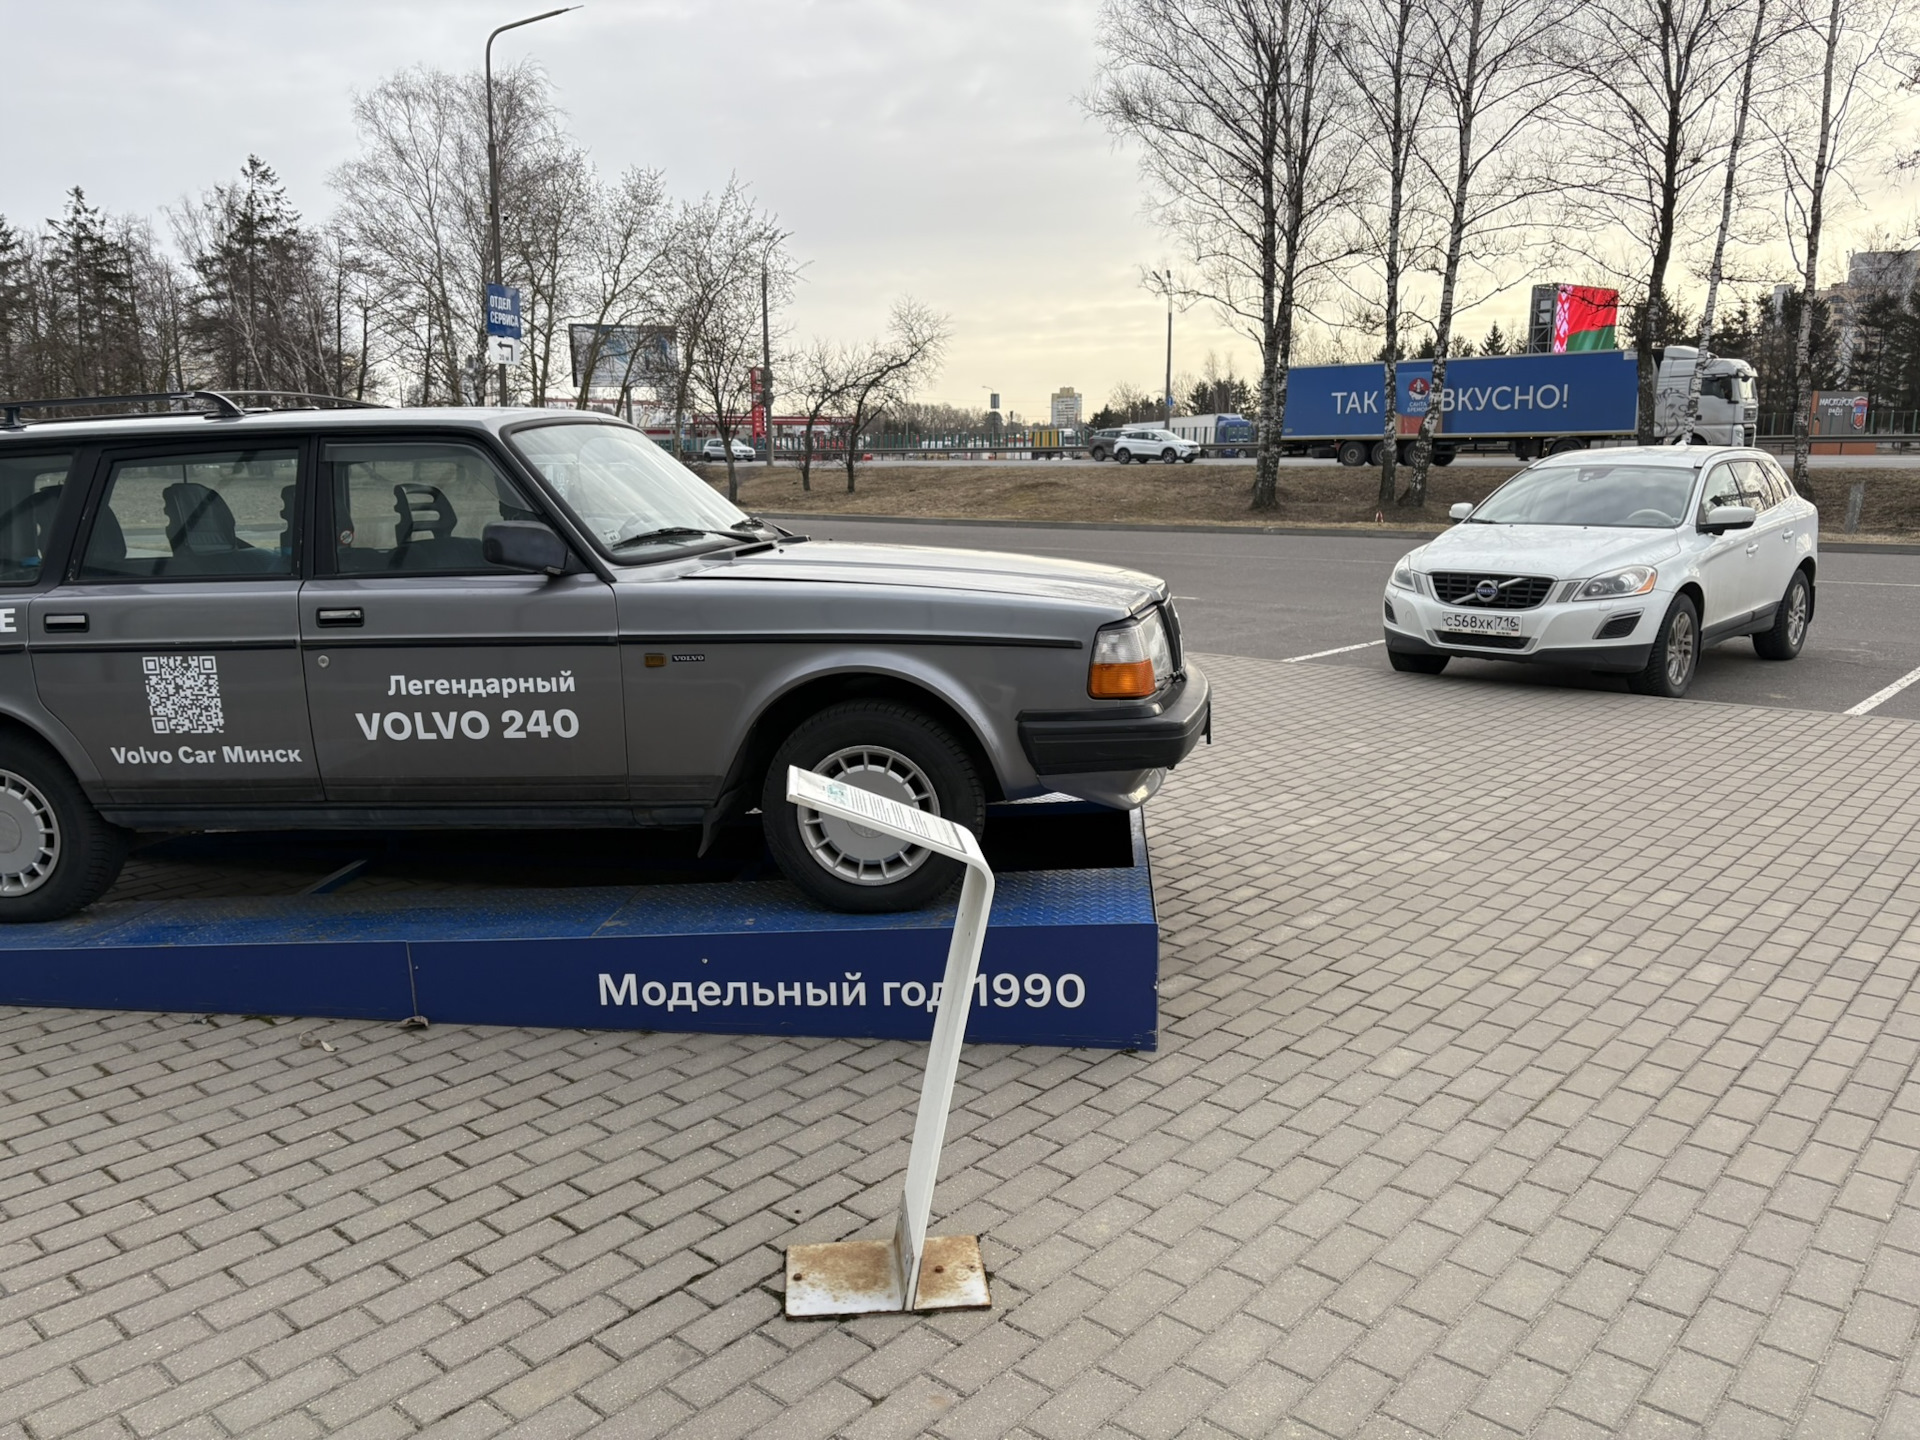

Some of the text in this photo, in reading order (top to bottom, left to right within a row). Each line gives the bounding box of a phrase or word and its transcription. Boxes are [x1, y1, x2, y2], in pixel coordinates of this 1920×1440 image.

[489, 295, 511, 311] ОТДЕЛ
[490, 311, 519, 327] СЕРВИСА
[1331, 383, 1570, 415] ТАК ВКУСНО!
[1496, 616, 1516, 628] 716
[388, 670, 576, 699] Легендарный
[354, 708, 580, 741] VOLVO 240
[110, 745, 303, 764] Volvo Car Минск
[598, 972, 867, 1013] Модельный
[973, 972, 1086, 1008] 1990
